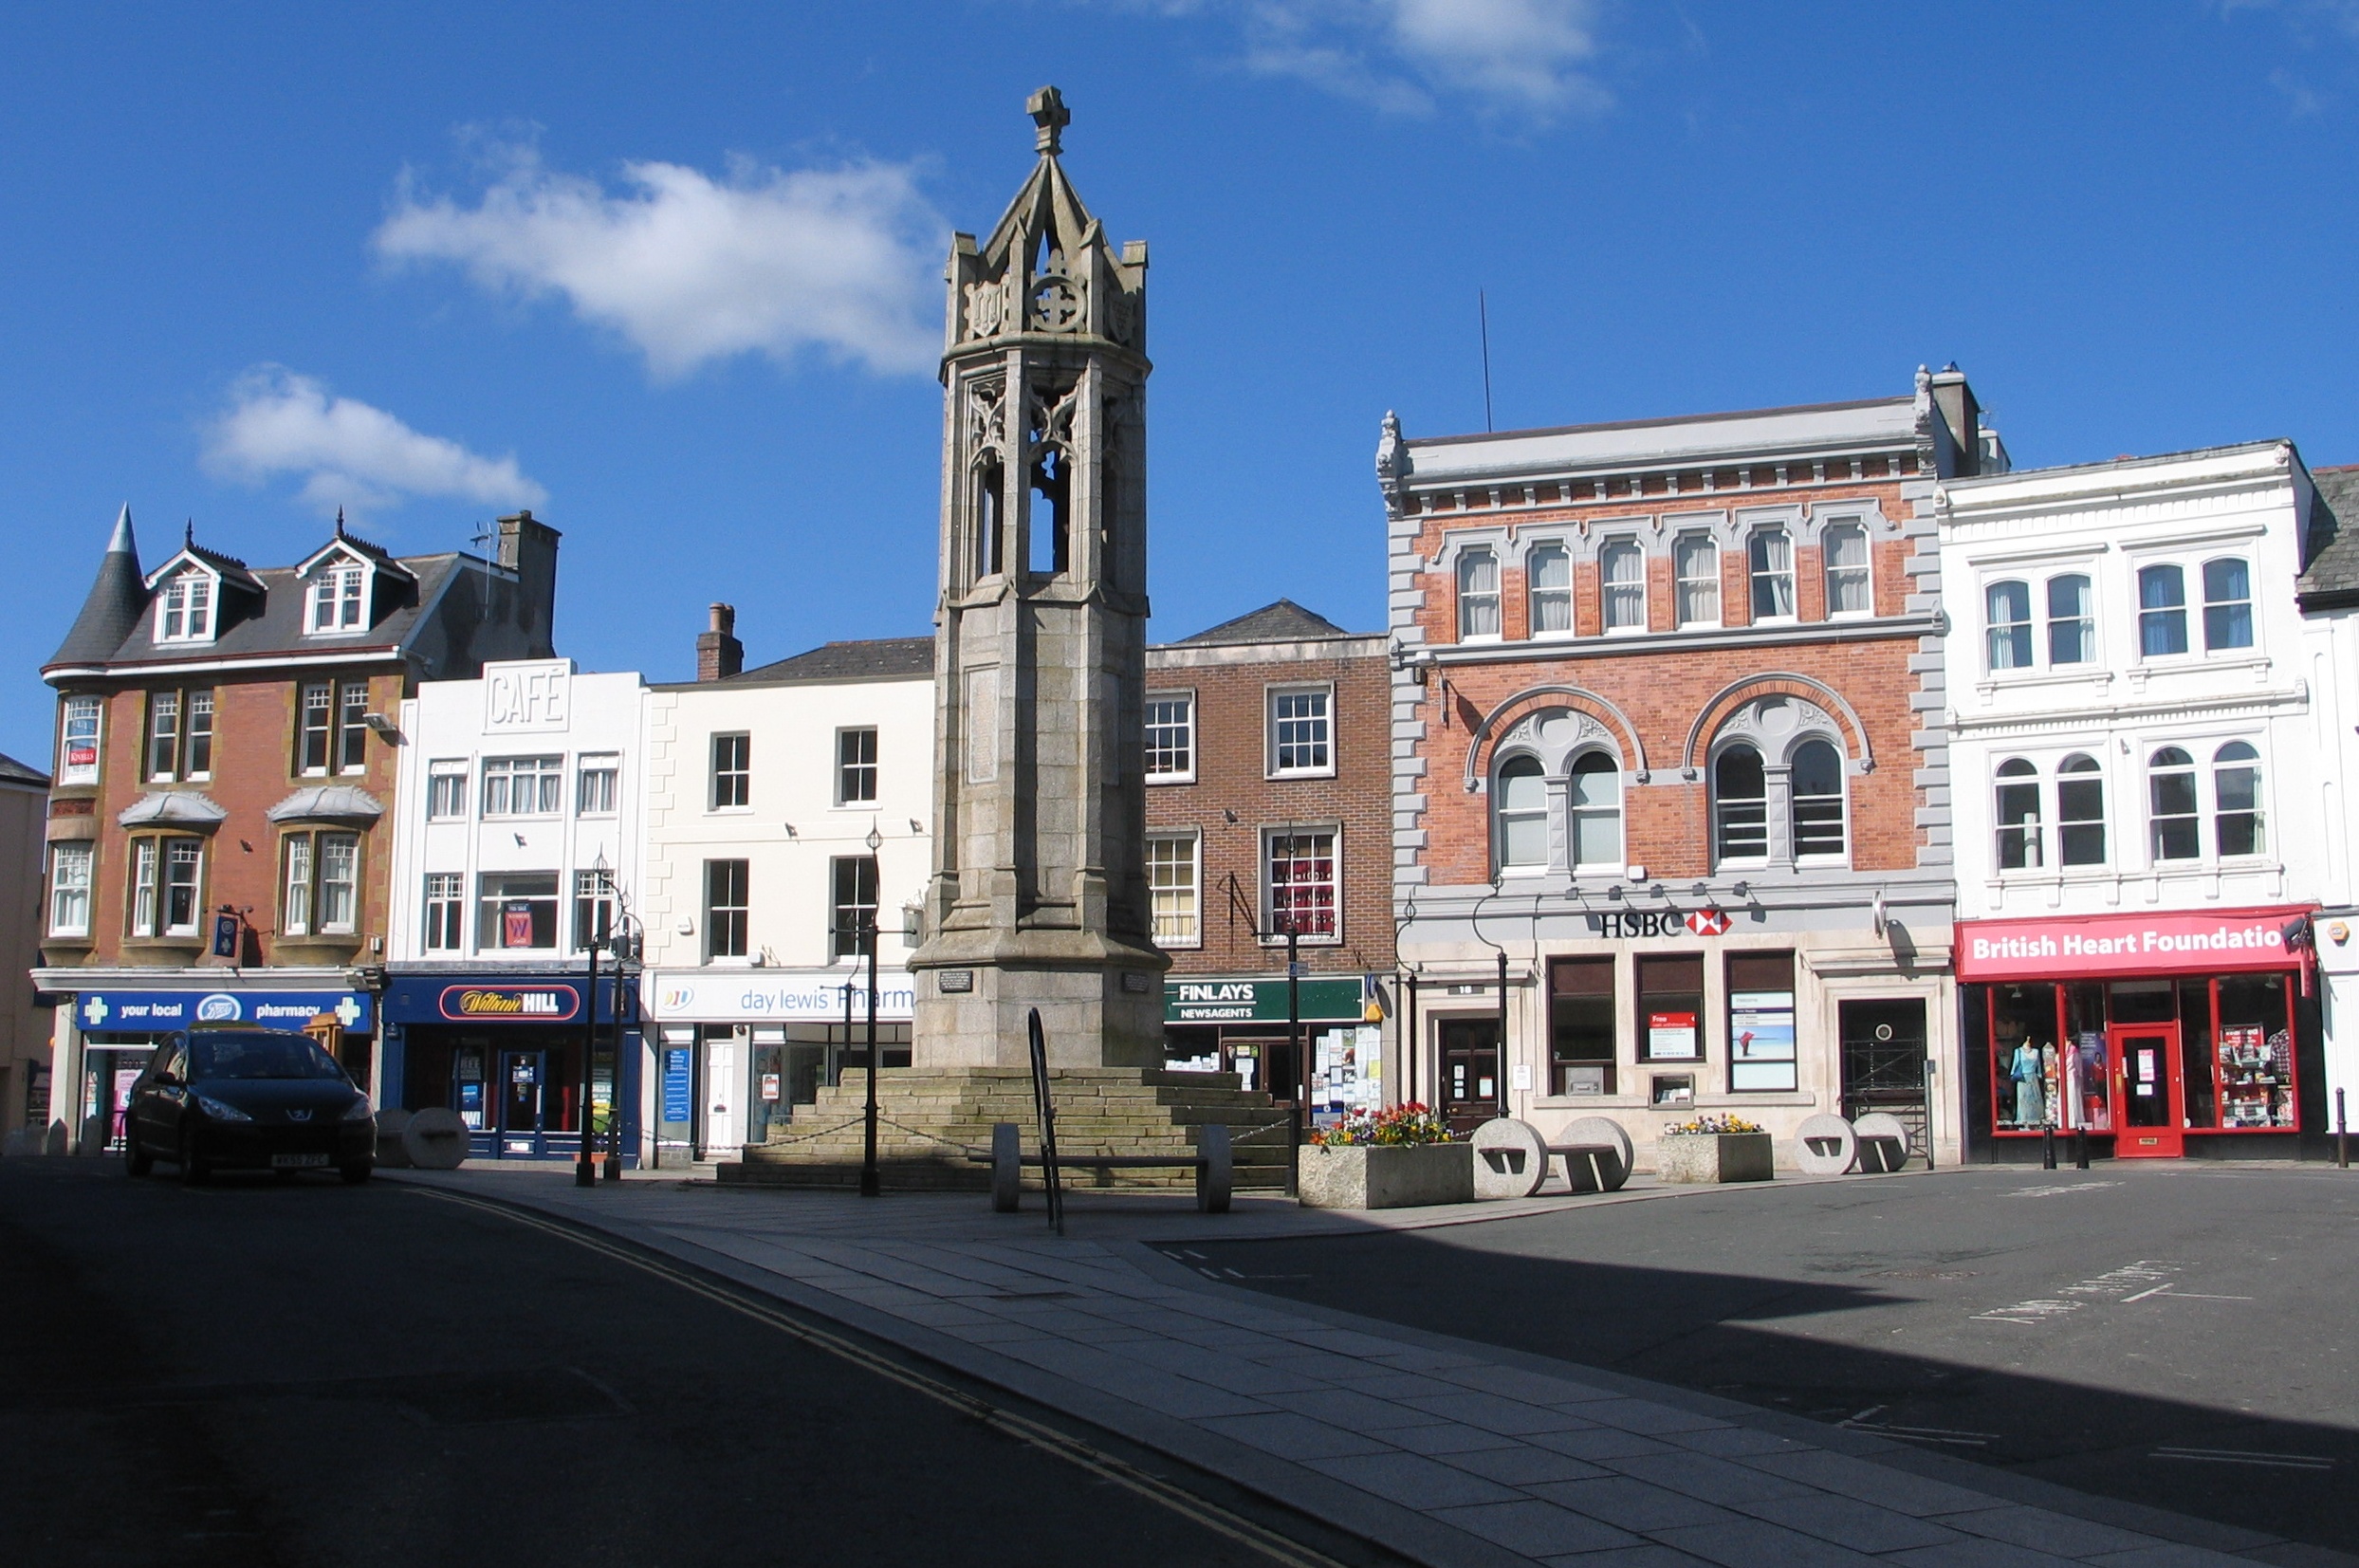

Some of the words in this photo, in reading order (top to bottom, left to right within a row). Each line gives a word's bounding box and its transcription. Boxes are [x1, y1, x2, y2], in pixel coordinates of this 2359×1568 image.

[490, 668, 565, 724] CAFÉ
[1601, 912, 1682, 939] HSBC
[1973, 935, 2057, 959] British
[2063, 933, 2137, 956] Heart
[2143, 925, 2282, 952] Foundatio
[1179, 984, 1254, 1001] FINLAYS
[1459, 986, 1472, 994] 18
[120, 1005, 150, 1019] your
[152, 1003, 182, 1017] local
[256, 1003, 321, 1020] pharmacy
[459, 990, 521, 1013] William
[523, 993, 559, 1012] HILL
[741, 989, 776, 1014] day
[780, 989, 829, 1009] lewis
[1180, 1007, 1253, 1019] NEWSAGENTS
